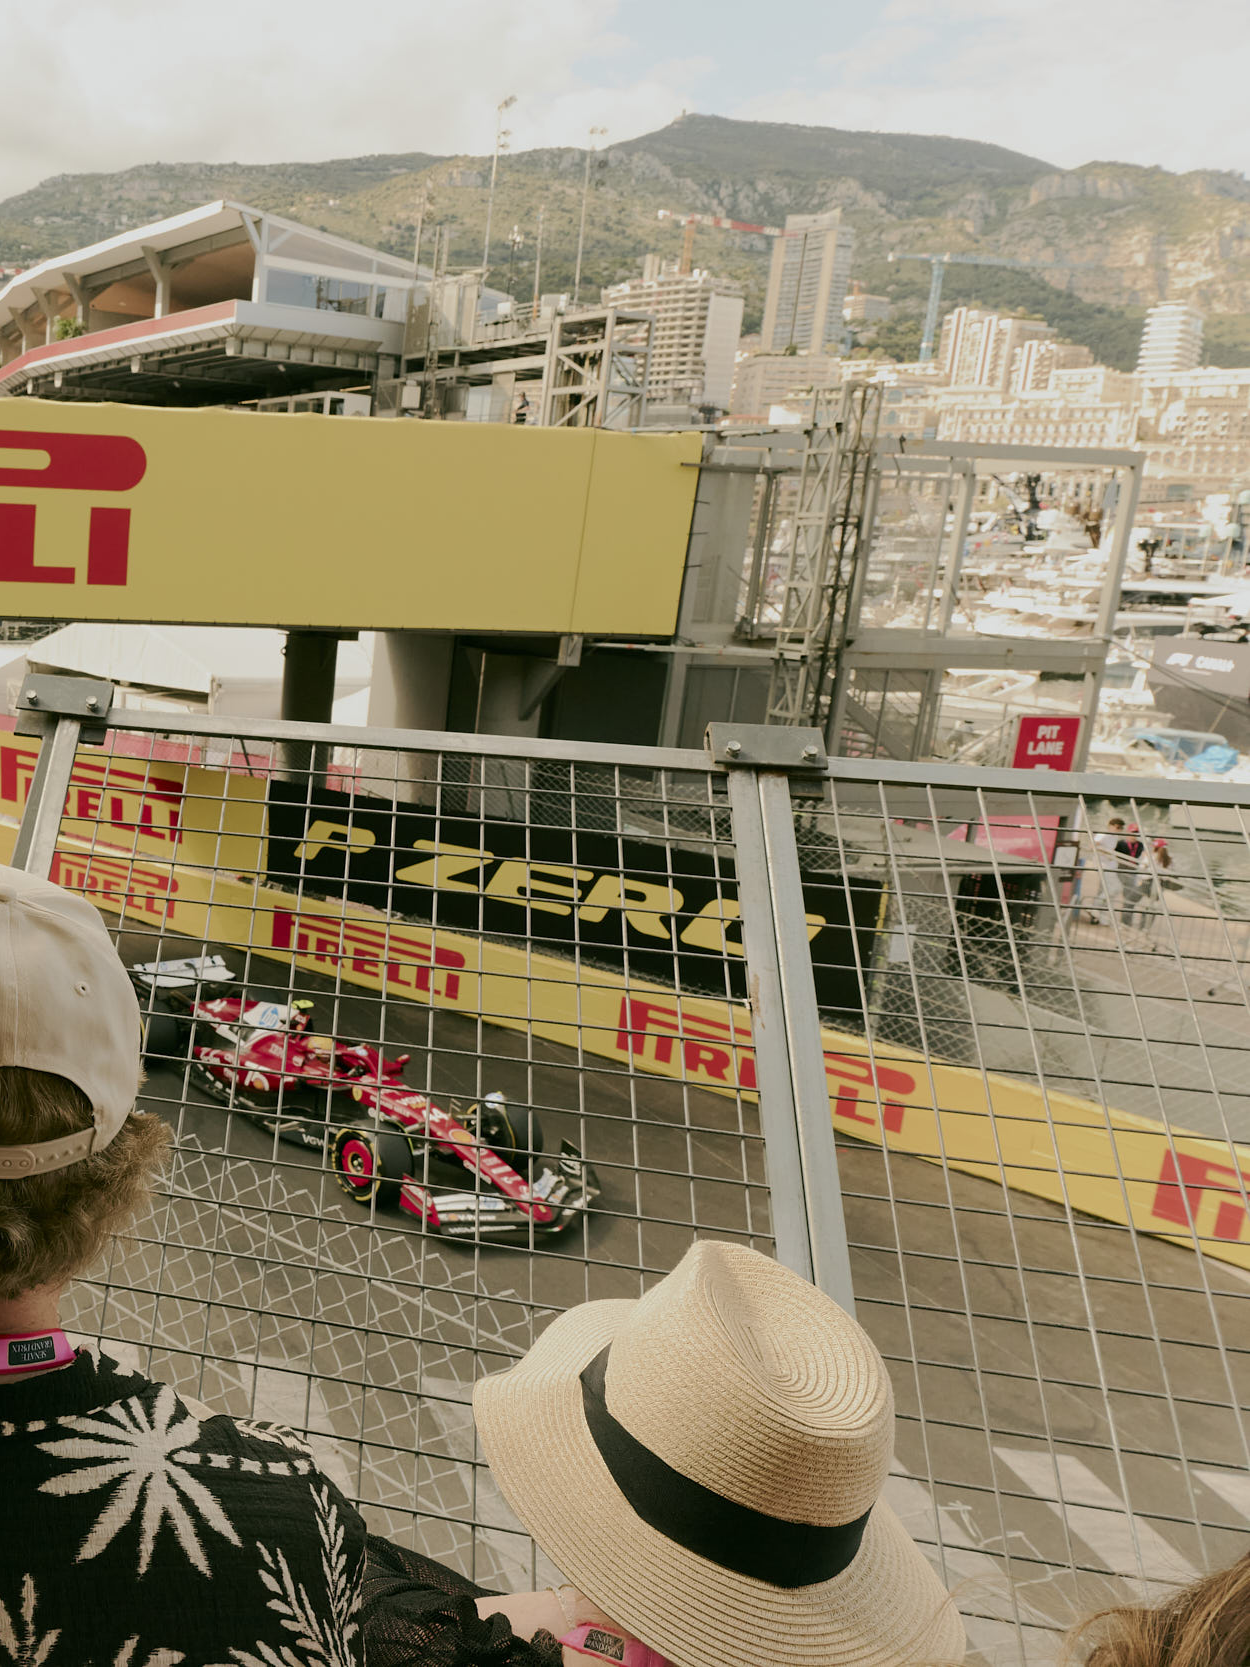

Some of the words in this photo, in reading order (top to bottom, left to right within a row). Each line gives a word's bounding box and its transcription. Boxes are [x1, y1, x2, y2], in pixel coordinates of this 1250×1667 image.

[1026, 741, 1065, 755] LANE
[1036, 724, 1061, 739] PIT
[294, 819, 376, 861] P
[49, 850, 179, 919] PIRELLI
[271, 904, 466, 1000] PIRELLI
